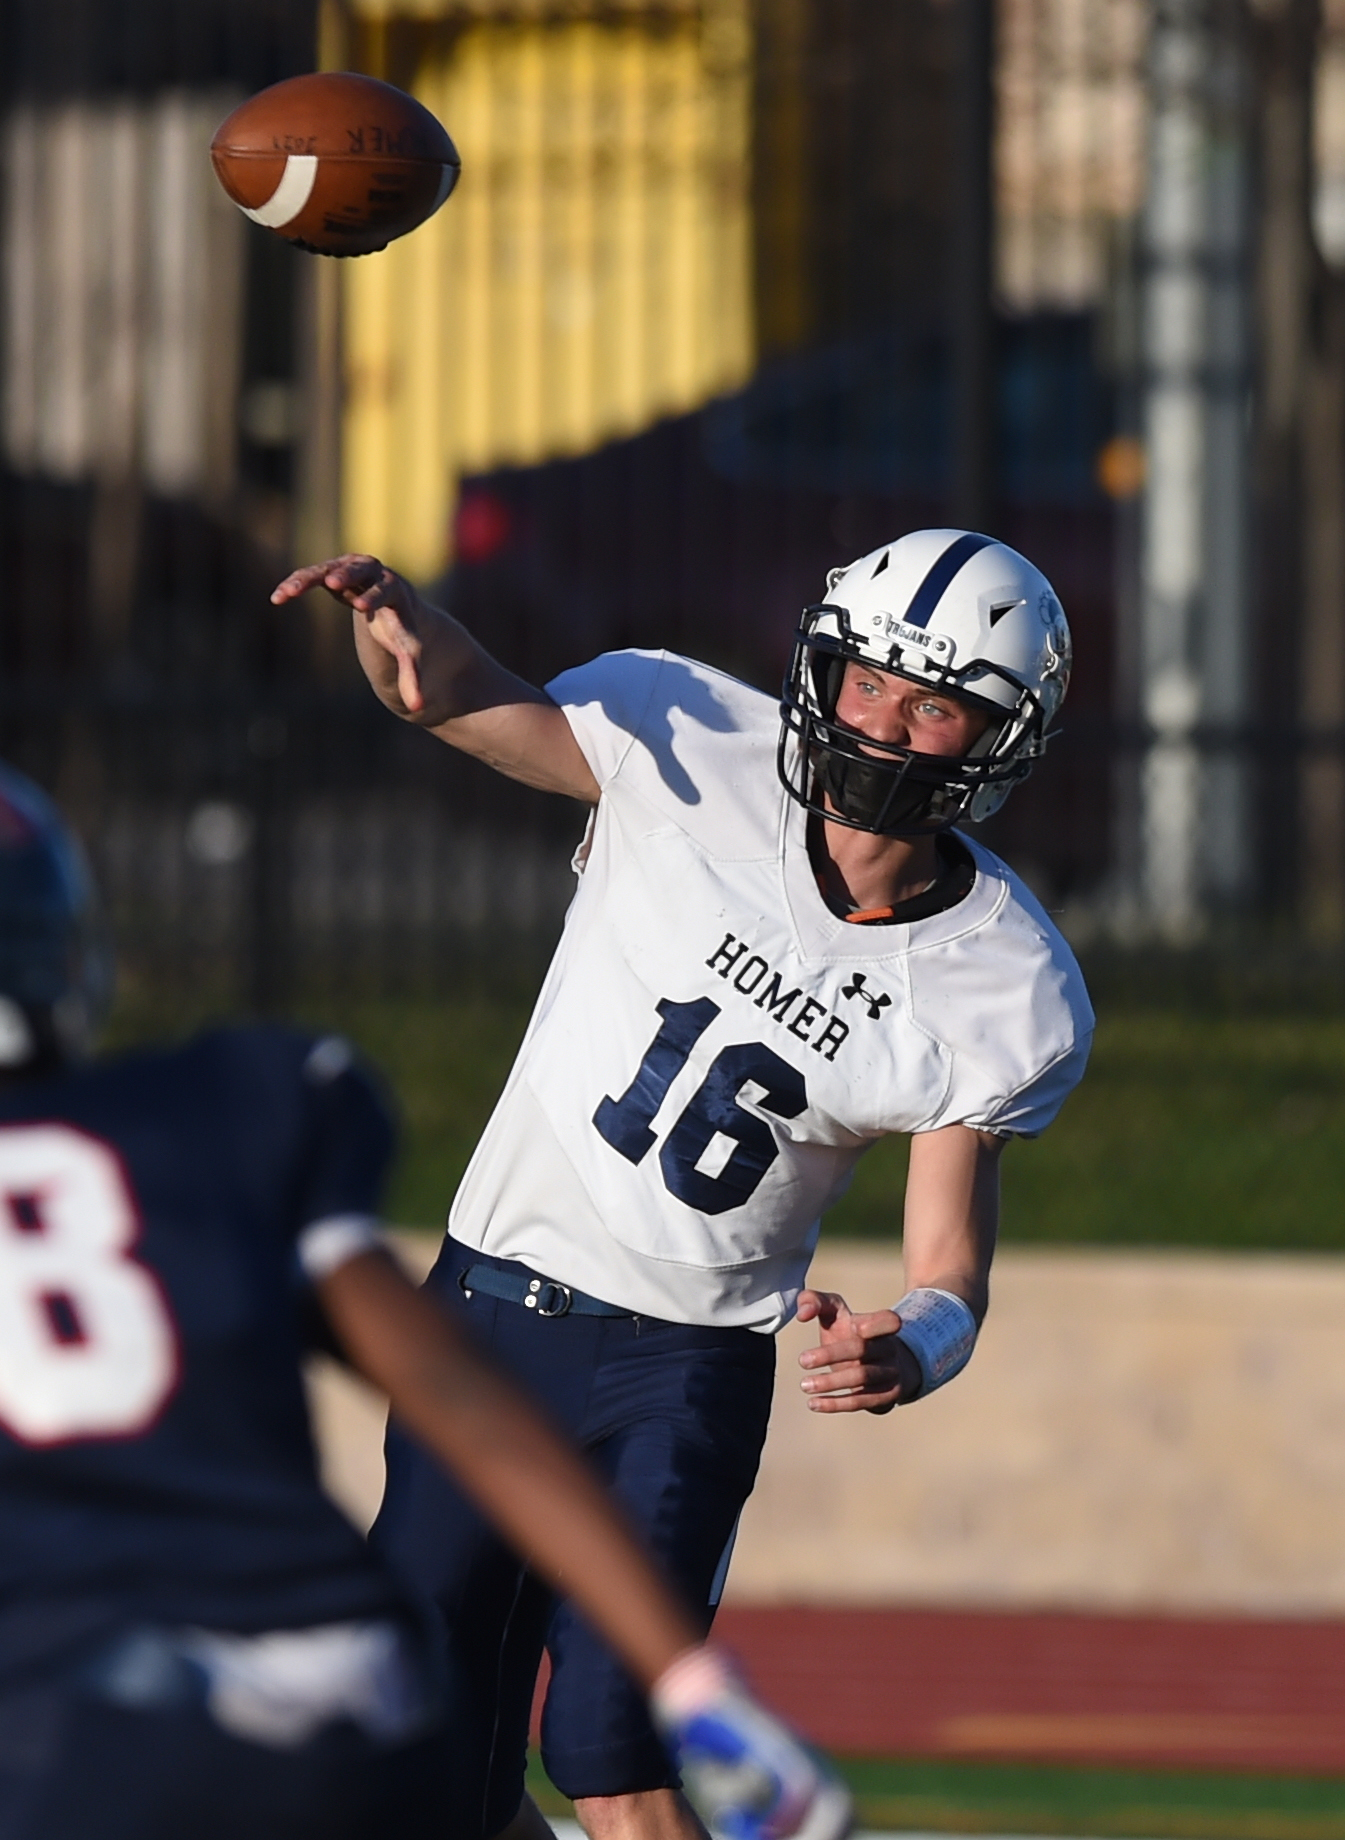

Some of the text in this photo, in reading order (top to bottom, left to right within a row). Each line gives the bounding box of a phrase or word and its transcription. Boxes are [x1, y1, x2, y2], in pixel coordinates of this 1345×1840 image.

[887, 620, 932, 648] TROJANS
[704, 932, 850, 1063] HOMER
[591, 995, 809, 1216] 16
